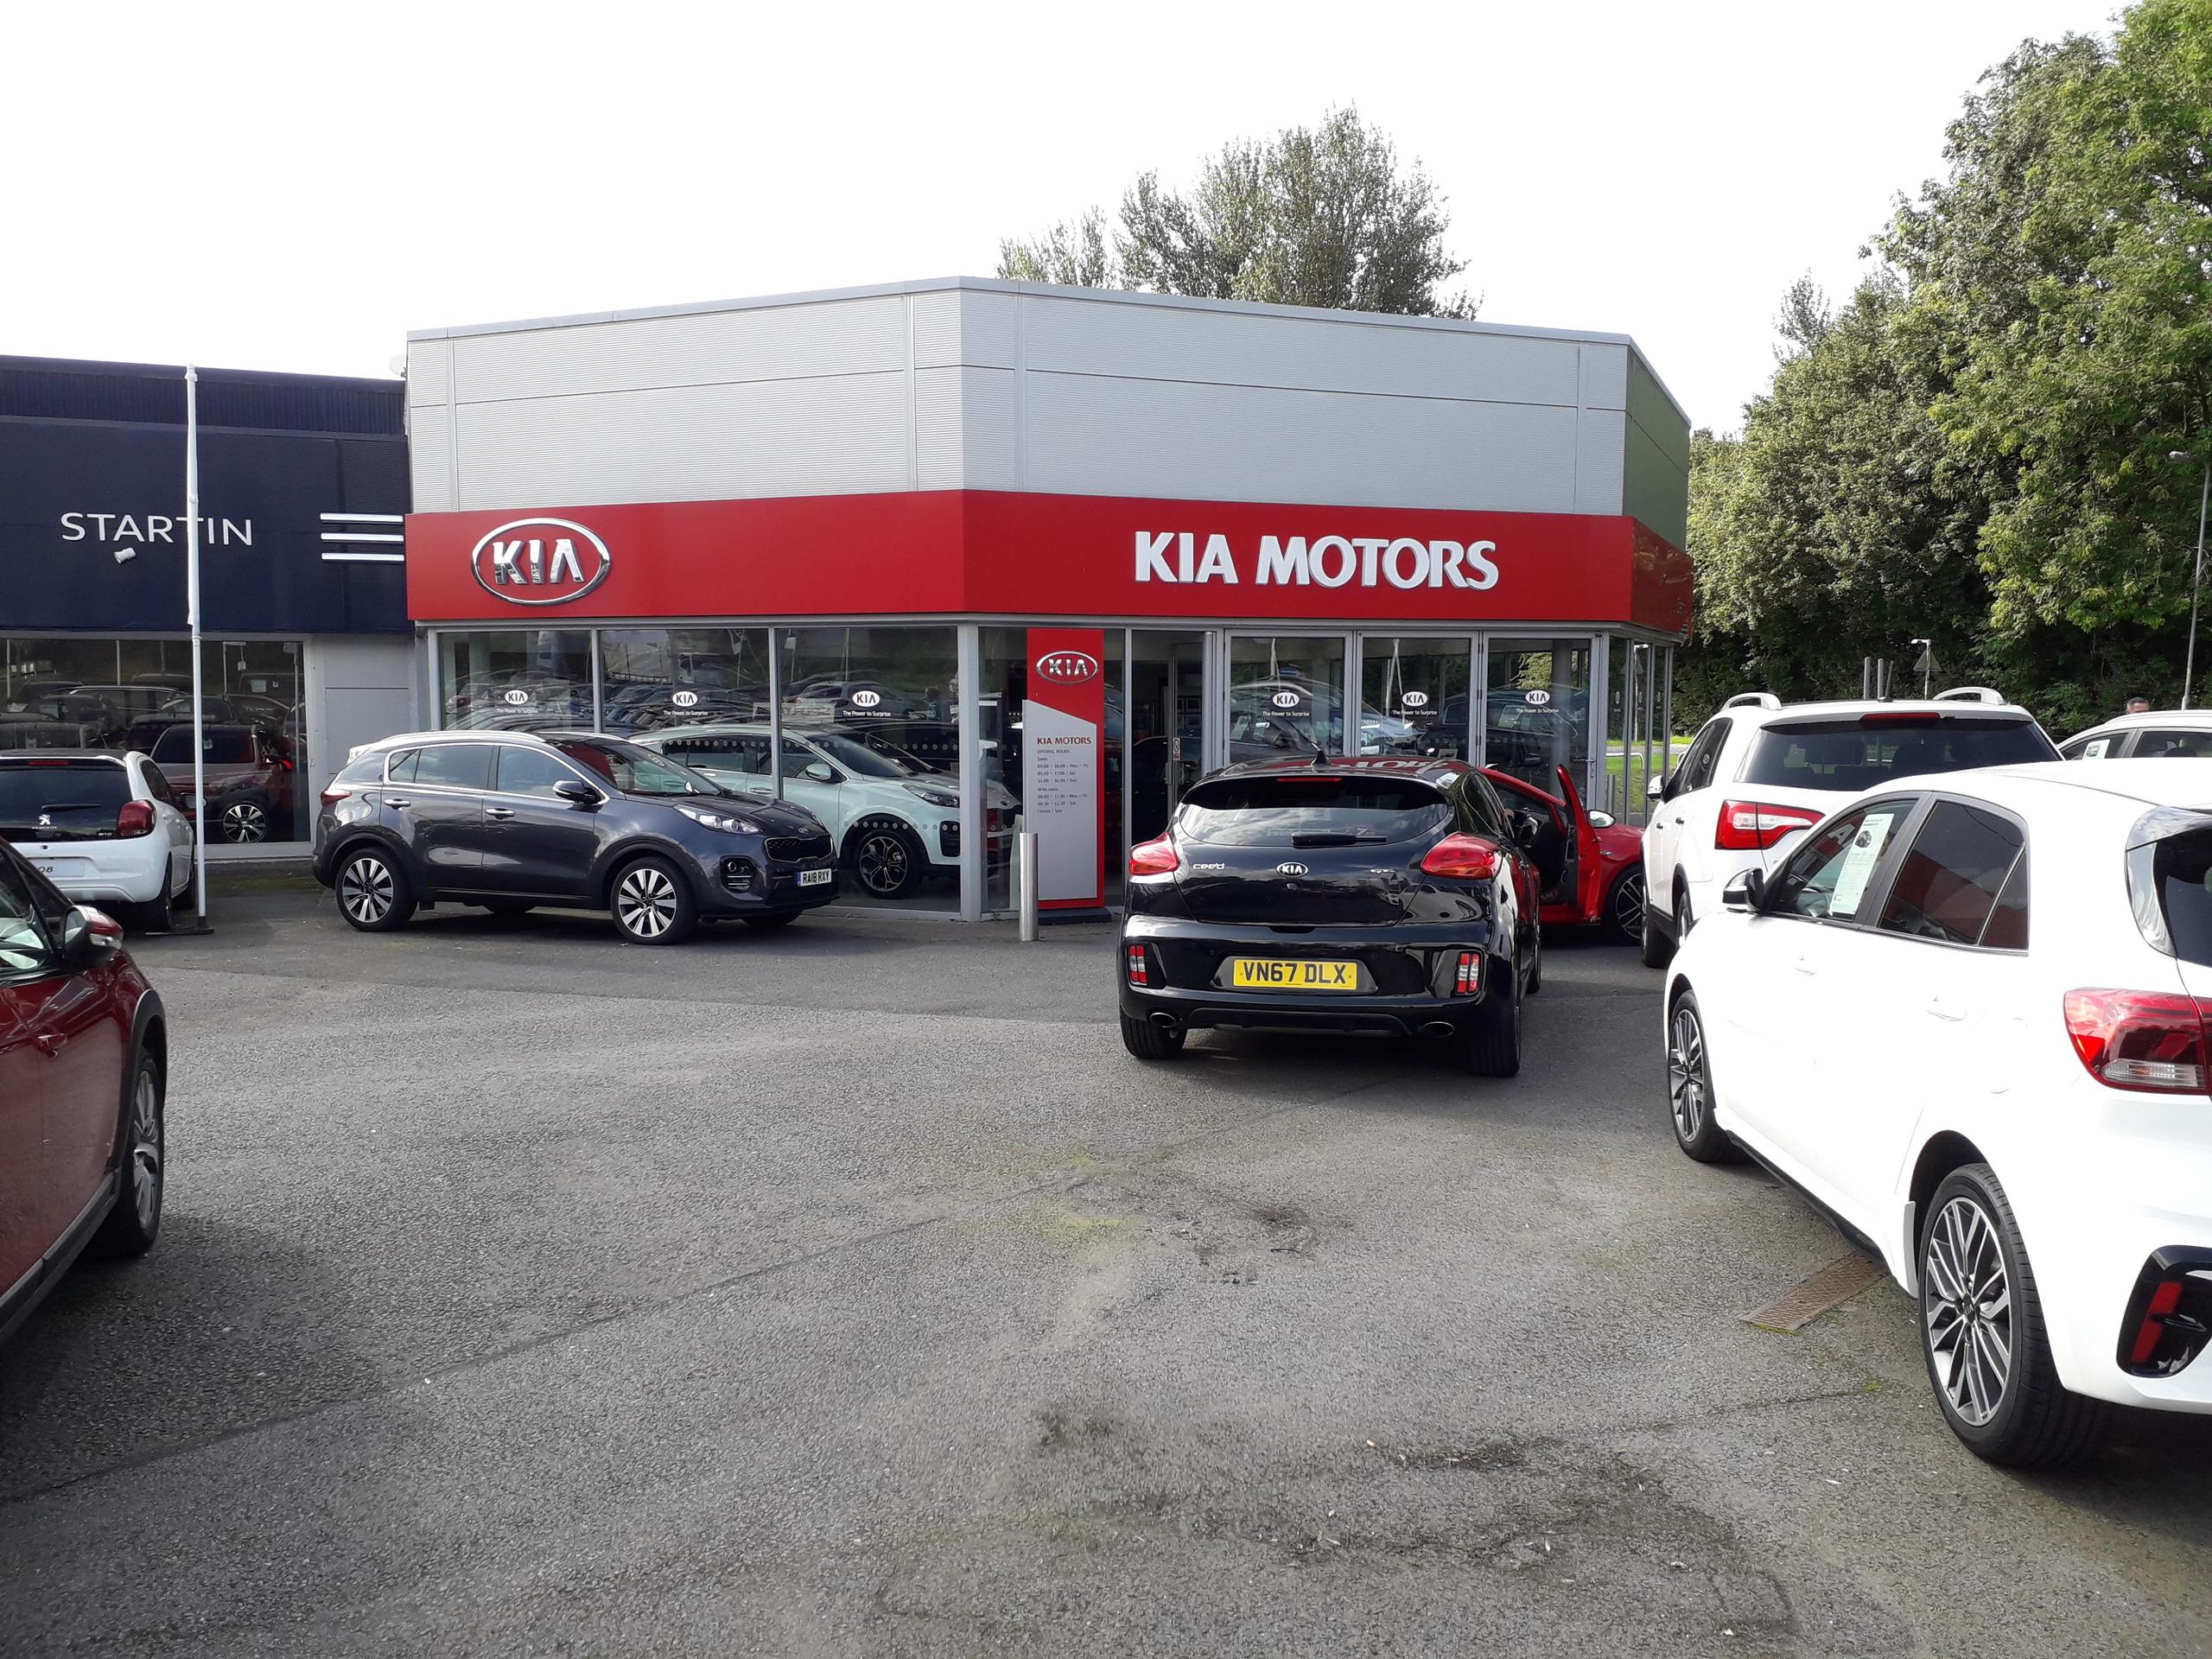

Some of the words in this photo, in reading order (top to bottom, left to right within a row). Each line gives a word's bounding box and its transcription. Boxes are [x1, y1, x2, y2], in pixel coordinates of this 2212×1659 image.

[493, 538, 585, 585] KIA
[1135, 531, 1239, 584] KIA
[1255, 535, 1499, 590] MOTORS
[1048, 658, 1088, 677] KIA
[507, 693, 524, 702] KIA
[676, 694, 694, 703] KIA
[856, 694, 876, 703] KIA
[1276, 696, 1296, 704] KIA
[1406, 695, 1424, 703] KIA
[1529, 693, 1547, 702] KIA
[1055, 736, 1092, 745] MOTORS
[1281, 865, 1303, 874] KIA
[818, 870, 830, 882] RXY
[1243, 962, 1298, 982] VN67
[1305, 963, 1346, 984] DLX
